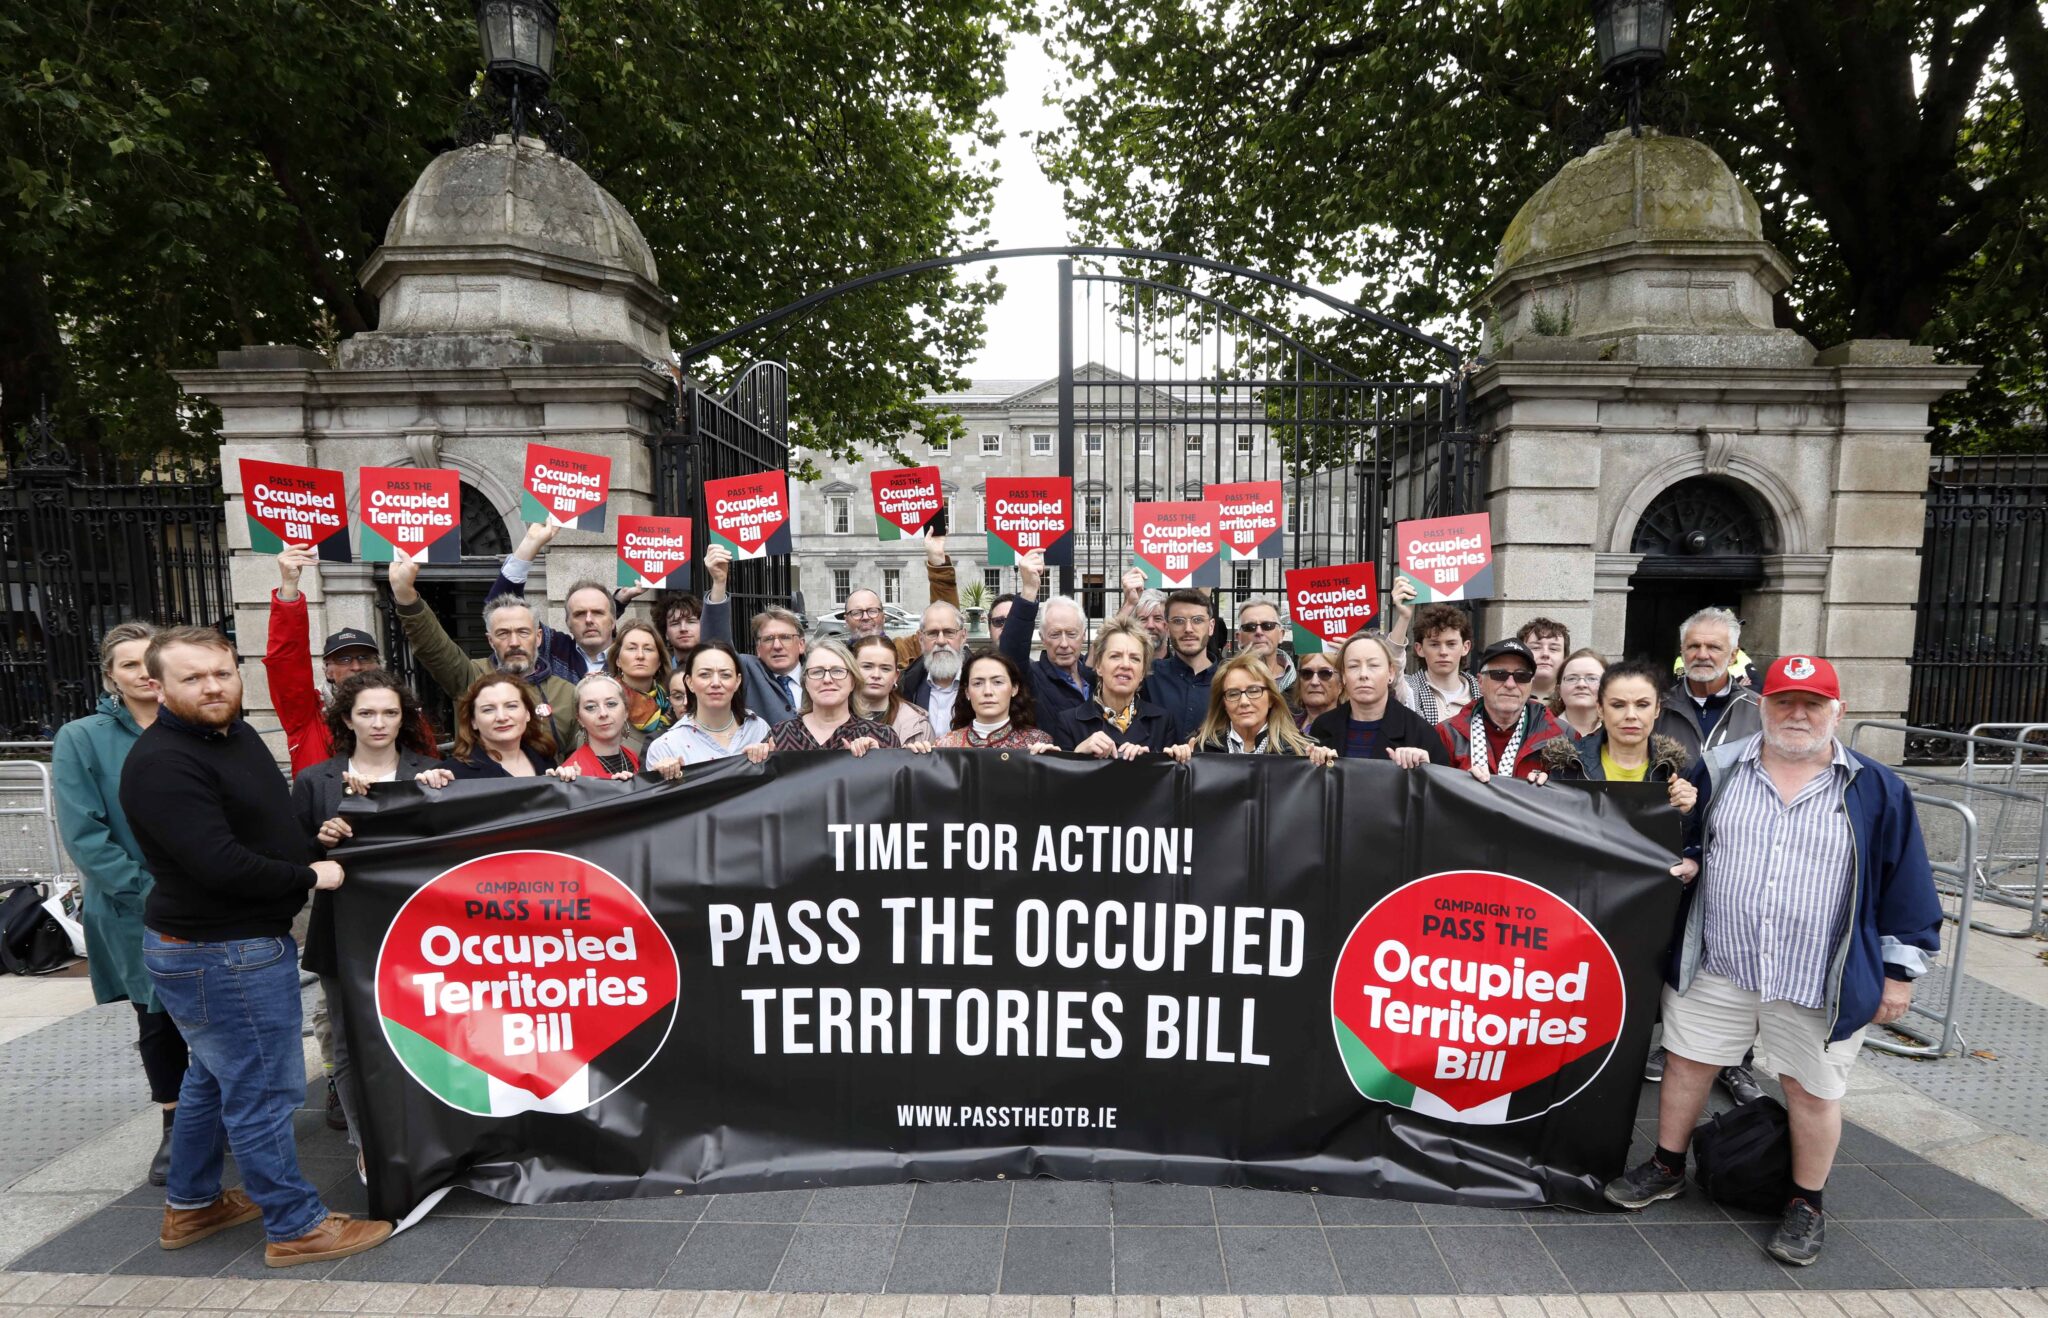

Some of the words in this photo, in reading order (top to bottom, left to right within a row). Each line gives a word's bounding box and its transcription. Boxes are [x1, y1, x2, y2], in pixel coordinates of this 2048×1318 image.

[551, 459, 569, 468] PASS
[572, 462, 587, 471] THE
[270, 476, 293, 487] PASS
[296, 479, 316, 489] THE
[535, 464, 600, 487] Occupied
[387, 481, 411, 490] PASS
[414, 482, 432, 491] THE
[531, 478, 600, 502] Territories
[728, 488, 745, 496] PASS
[748, 485, 763, 494] THE
[880, 484, 934, 500] Occupied
[1010, 490, 1029, 498] PASS
[1032, 490, 1047, 498] THE
[254, 484, 335, 508] Occupied
[371, 491, 448, 509] Occupied
[716, 492, 778, 513] Occupied
[554, 497, 575, 512] Bill
[879, 500, 937, 513] Territories
[996, 500, 1062, 515] Occupied
[253, 501, 339, 526] Territories
[368, 508, 452, 525] Territories
[715, 510, 781, 530] Territories
[901, 512, 919, 525] Bill
[285, 522, 312, 539] Bill
[993, 516, 1064, 531] Territories
[1143, 523, 1210, 538] Occupied
[1220, 515, 1276, 530] erritories
[398, 526, 423, 542] Bill
[626, 533, 682, 547] Occupied
[740, 527, 761, 541] Bill
[1018, 532, 1040, 547] Bill
[1234, 530, 1254, 543] Bill
[1424, 530, 1445, 538] PASS
[1141, 539, 1213, 554] Territories
[1409, 534, 1481, 554] Occupied
[623, 546, 684, 560] Territories
[1407, 552, 1485, 570] Territories
[644, 561, 663, 573] Bill
[1166, 555, 1188, 569] Bill
[1311, 580, 1330, 588] PASS
[1334, 578, 1350, 586] THE
[1435, 568, 1458, 583] Bill
[1298, 585, 1366, 604] Occupied
[1296, 603, 1370, 621] Territories
[1324, 620, 1346, 634] Bill
[829, 824, 928, 871] TIME
[944, 823, 1018, 870] FOR
[1032, 826, 1194, 875] ACTION!
[476, 881, 554, 894] CAMPAIGN
[559, 881, 579, 893] TO
[466, 900, 529, 921] PASS
[540, 898, 591, 921] THE
[1434, 898, 1510, 917] CAMPAIGN
[1515, 907, 1536, 920] TO
[708, 897, 860, 967] PASS
[882, 897, 994, 966] THE
[1016, 899, 1305, 977] OCCUPIED
[1423, 915, 1485, 942] PASS
[1495, 923, 1548, 950] THE
[420, 925, 637, 968] Occupied
[1374, 939, 1589, 1002] Occupied
[413, 968, 648, 1017] Territories
[1363, 985, 1587, 1046] Territories
[502, 1013, 573, 1056] Bill
[741, 988, 1124, 1060] TERRITORIES
[1146, 995, 1270, 1066] BILL
[1434, 1046, 1506, 1081] Bill
[897, 1105, 1118, 1129] WWW.PASSTHEOTB.IE
